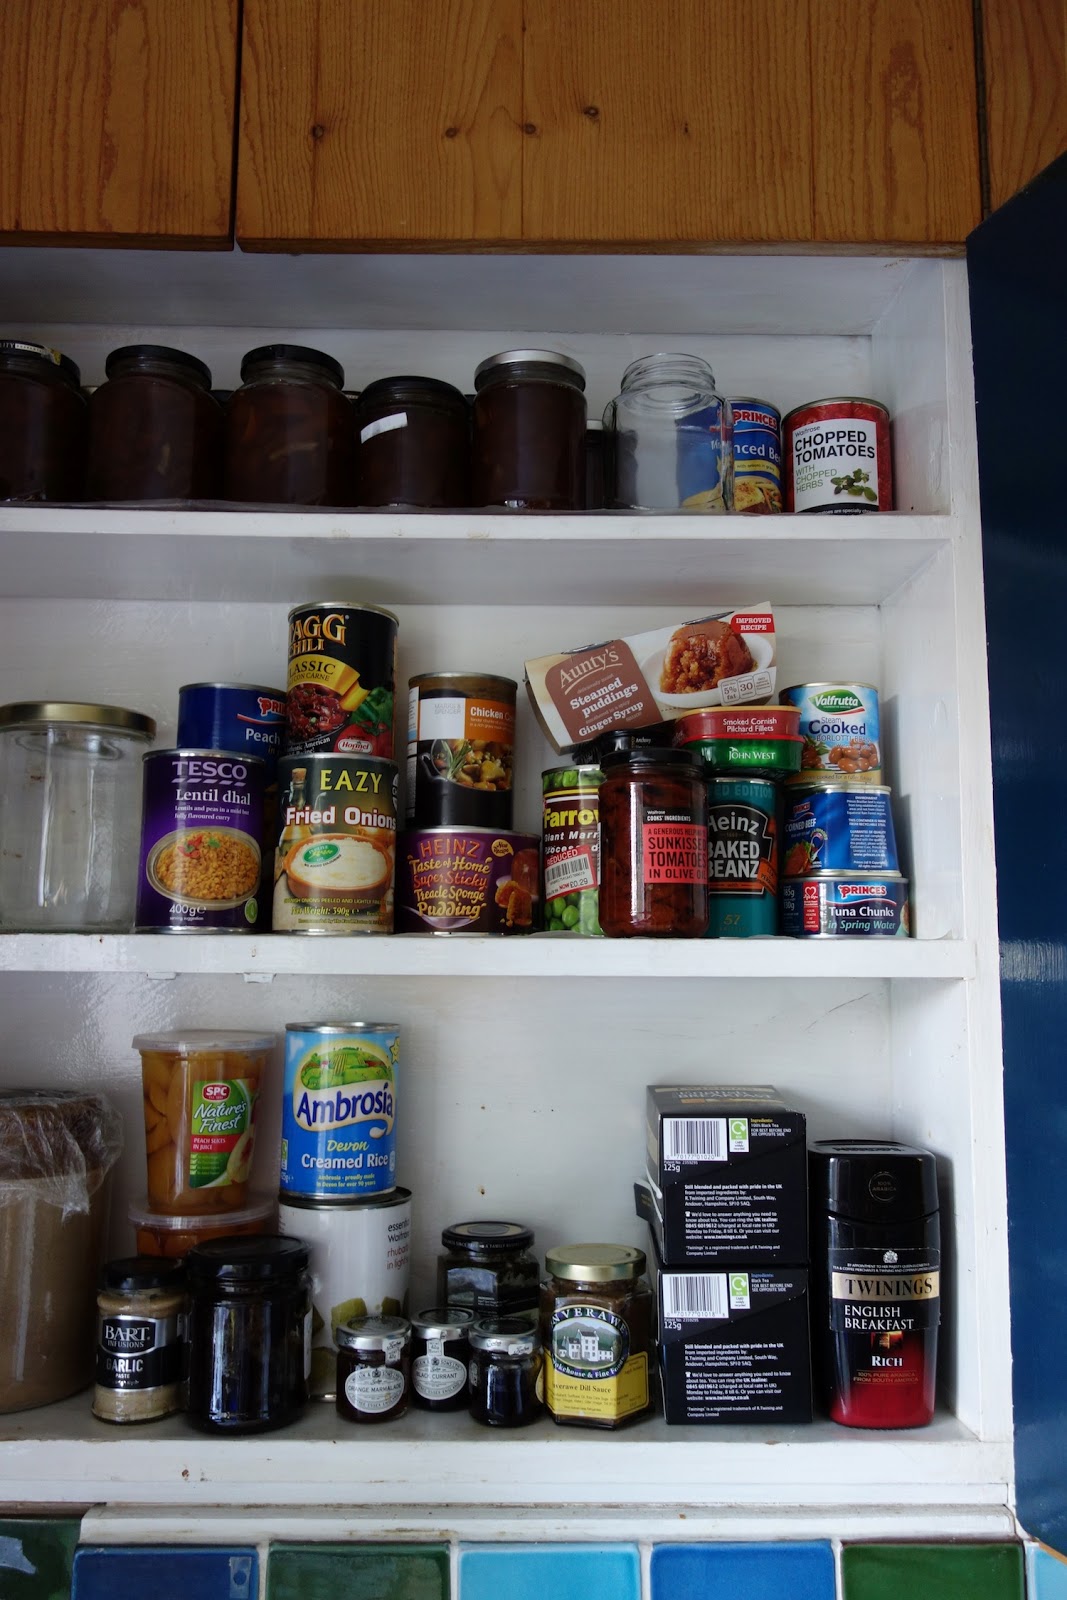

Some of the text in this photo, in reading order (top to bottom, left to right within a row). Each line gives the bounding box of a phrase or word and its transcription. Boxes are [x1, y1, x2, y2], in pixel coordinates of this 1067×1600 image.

[795, 426, 821, 437] Waitrose
[795, 430, 867, 452] CHOPPED
[733, 444, 766, 457] nced
[796, 444, 875, 466] TOMATOES
[796, 464, 815, 477] WITH
[796, 468, 837, 486] CHOPPED
[797, 479, 824, 494] HERBS
[289, 660, 336, 678] LASSIC
[560, 649, 619, 688] Aunty's
[306, 672, 330, 681] CARNE
[570, 677, 623, 710] Steamed
[740, 682, 753, 692] 30
[582, 683, 639, 718] puddings
[815, 694, 859, 707] Valfrutta
[470, 706, 504, 720] Chicken
[578, 715, 613, 737] Ginger
[613, 701, 644, 721] Syrup
[723, 717, 777, 726] Smoked Cornish
[808, 720, 866, 735] Cooked
[341, 741, 369, 750] Hormel
[728, 750, 776, 760] JOHN WEST
[172, 761, 247, 780] TESCO
[320, 769, 382, 793] EAZY
[176, 788, 251, 805] Lentil dhal
[734, 784, 773, 799] EDITION
[286, 806, 396, 830] Fried Onions
[544, 807, 600, 828] Farro
[708, 811, 760, 836] Heinz
[805, 818, 817, 828] BEEF
[569, 830, 599, 840] Marr
[421, 838, 480, 858] HEINZ
[648, 837, 706, 851] SUNKISSED
[708, 840, 760, 859] BAKED
[547, 849, 578, 866] REDUCED
[649, 851, 706, 868] TOMATOES
[409, 858, 442, 874] Taste
[442, 857, 452, 868] of
[413, 870, 487, 892] Super Sticky
[649, 868, 661, 879] IN
[665, 868, 694, 879] OLIVE
[570, 877, 588, 889] £0.29
[414, 885, 485, 904] Treacle Sponge
[838, 885, 887, 899] PRINCES
[417, 901, 486, 920] Pudding
[828, 906, 894, 917] Tuna Chunks
[724, 914, 741, 925] 57
[828, 920, 896, 931] in Spring Water
[206, 1086, 228, 1096] SPC
[194, 1102, 247, 1119] Nature's
[297, 1082, 393, 1127] Ambrosia
[199, 1114, 242, 1133] Finest
[327, 1139, 369, 1152] Devon
[301, 1153, 388, 1169] Creamed Rice
[664, 1164, 680, 1173] 125g
[387, 1245, 408, 1257] rhubar
[845, 1277, 932, 1296] TWININGS
[844, 1304, 901, 1318] ENGLISH
[664, 1322, 681, 1330] 125g
[844, 1318, 914, 1330] BREAKFAST
[105, 1325, 149, 1341] BART
[107, 1340, 144, 1348] INFUSIONS
[106, 1358, 144, 1373] GARLIC
[579, 1383, 611, 1393] Dill Sauce
